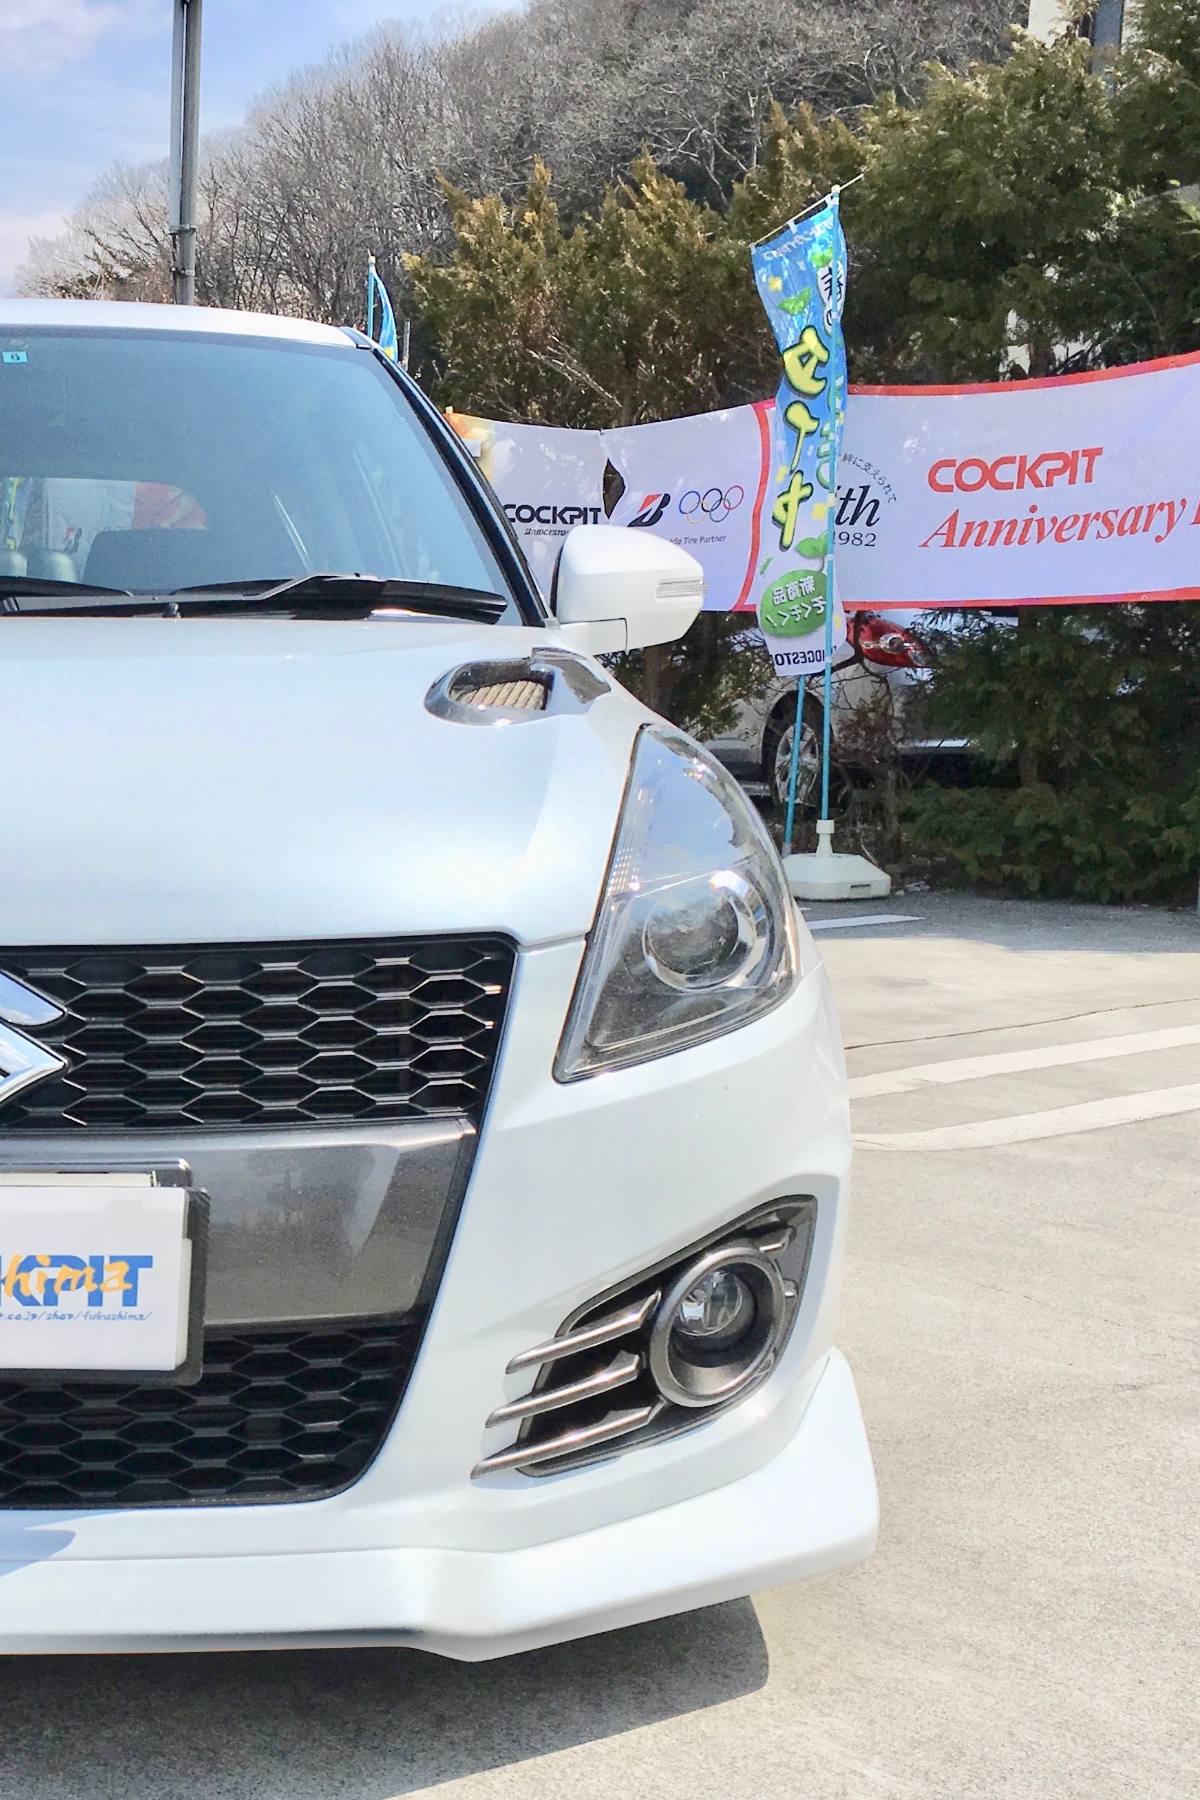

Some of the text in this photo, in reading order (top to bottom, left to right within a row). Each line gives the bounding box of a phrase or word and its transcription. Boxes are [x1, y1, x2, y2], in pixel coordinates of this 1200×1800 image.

[928, 447, 1103, 493] COCKPIT
[502, 504, 601, 525] COCKPIT
[919, 498, 1187, 548] Anniversary
[524, 528, 569, 536] BRIDGESTO
[700, 535, 727, 544] Partner
